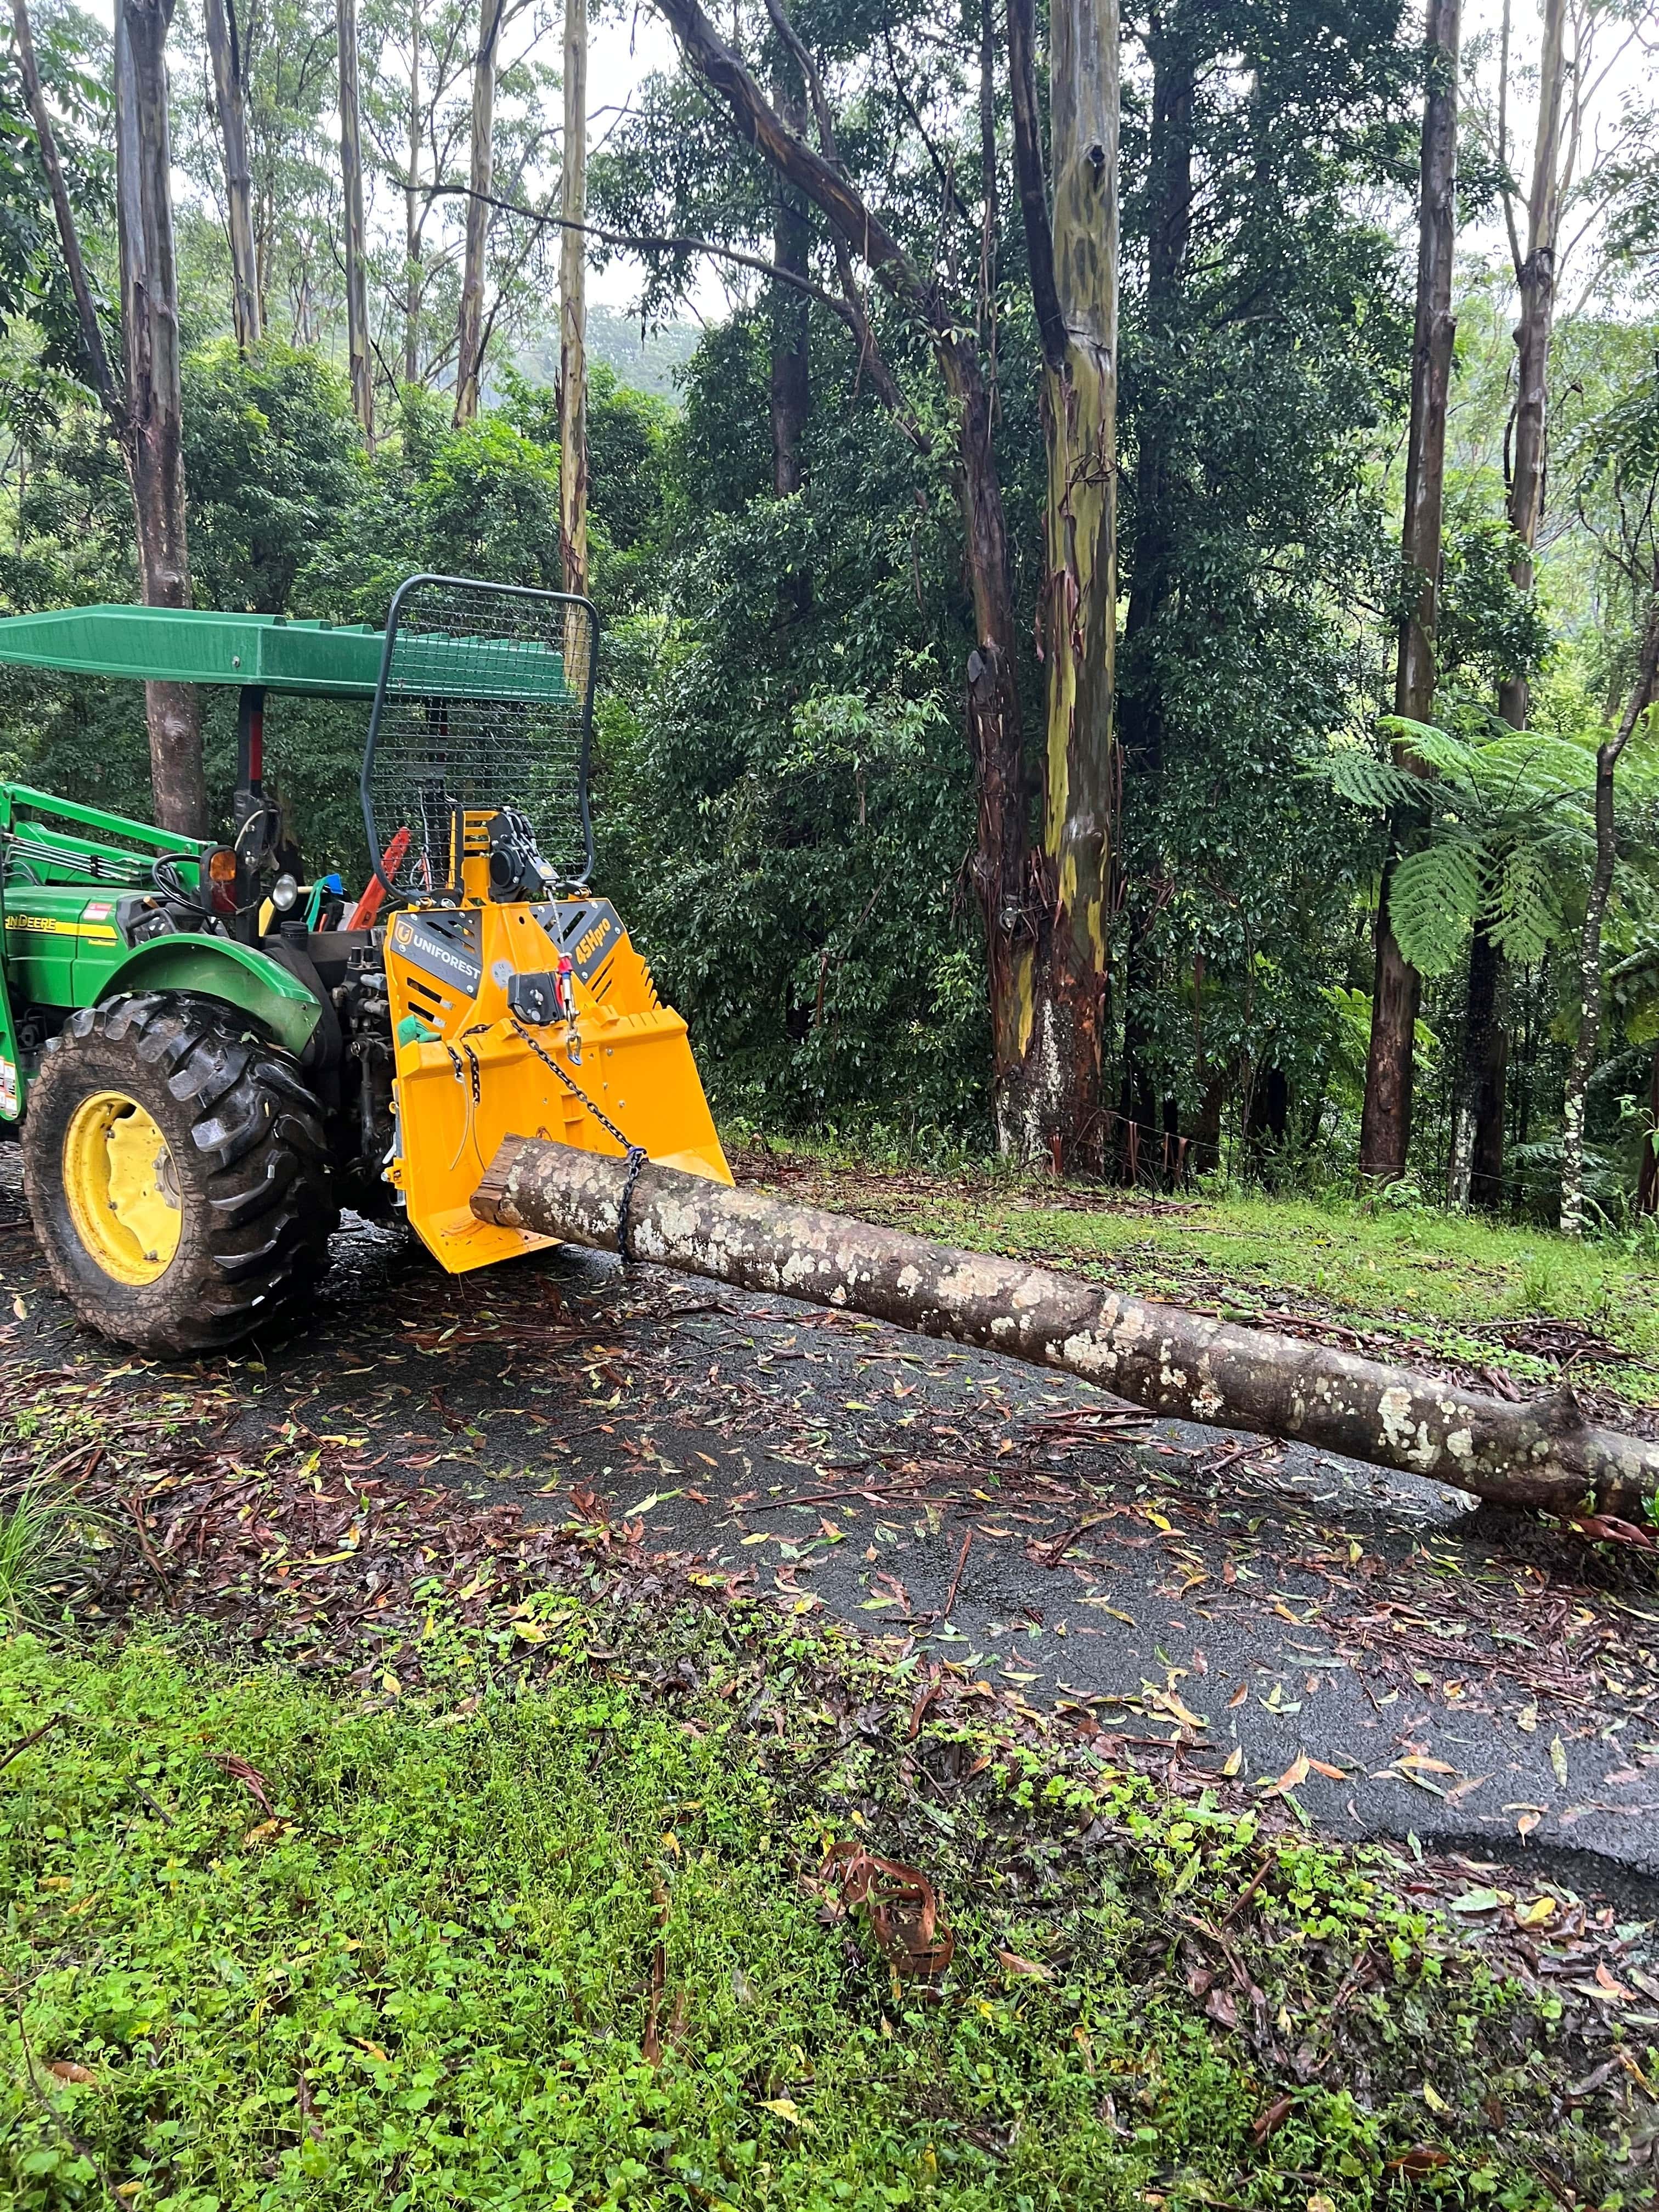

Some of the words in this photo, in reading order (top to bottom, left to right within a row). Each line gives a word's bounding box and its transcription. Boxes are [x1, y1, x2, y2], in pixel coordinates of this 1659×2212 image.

[18, 914, 57, 930] DEERE
[575, 918, 611, 964] 45Hpro
[413, 934, 481, 979] UNIFOREST
